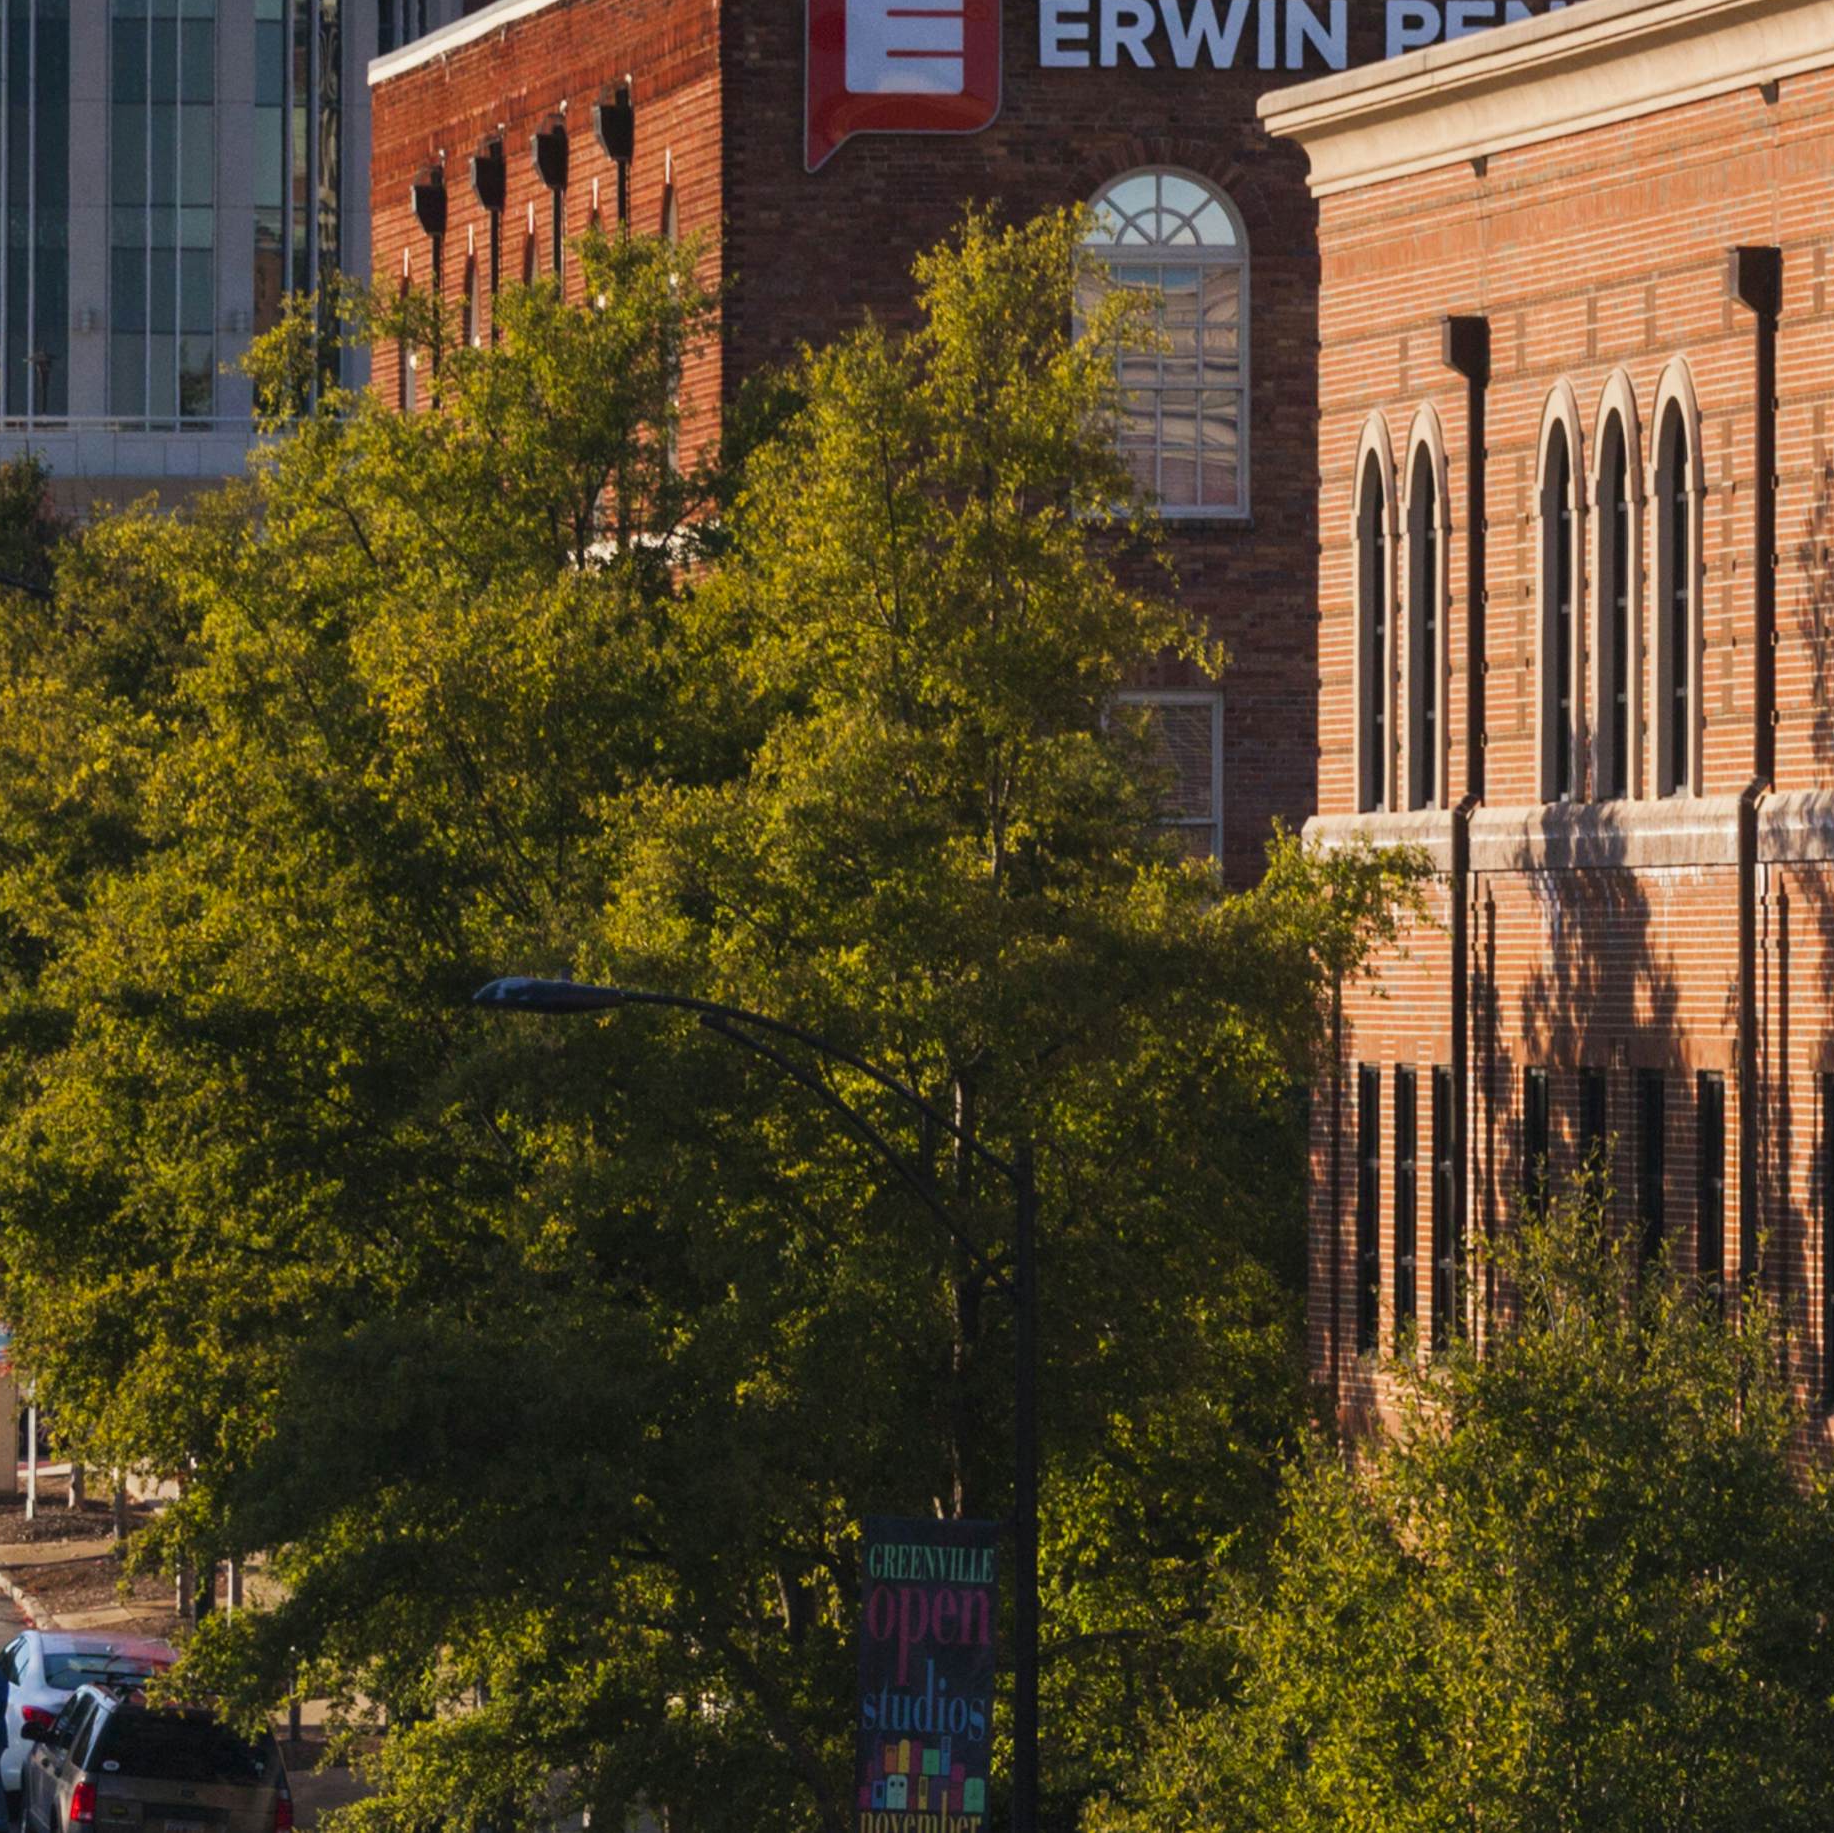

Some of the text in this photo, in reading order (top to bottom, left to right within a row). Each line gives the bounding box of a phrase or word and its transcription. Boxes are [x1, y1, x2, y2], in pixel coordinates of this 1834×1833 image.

[869, 1543, 995, 1583] GREENVILLE
[867, 1584, 991, 1686] open
[861, 1658, 986, 1742] studios
[859, 1790, 983, 1833] november
